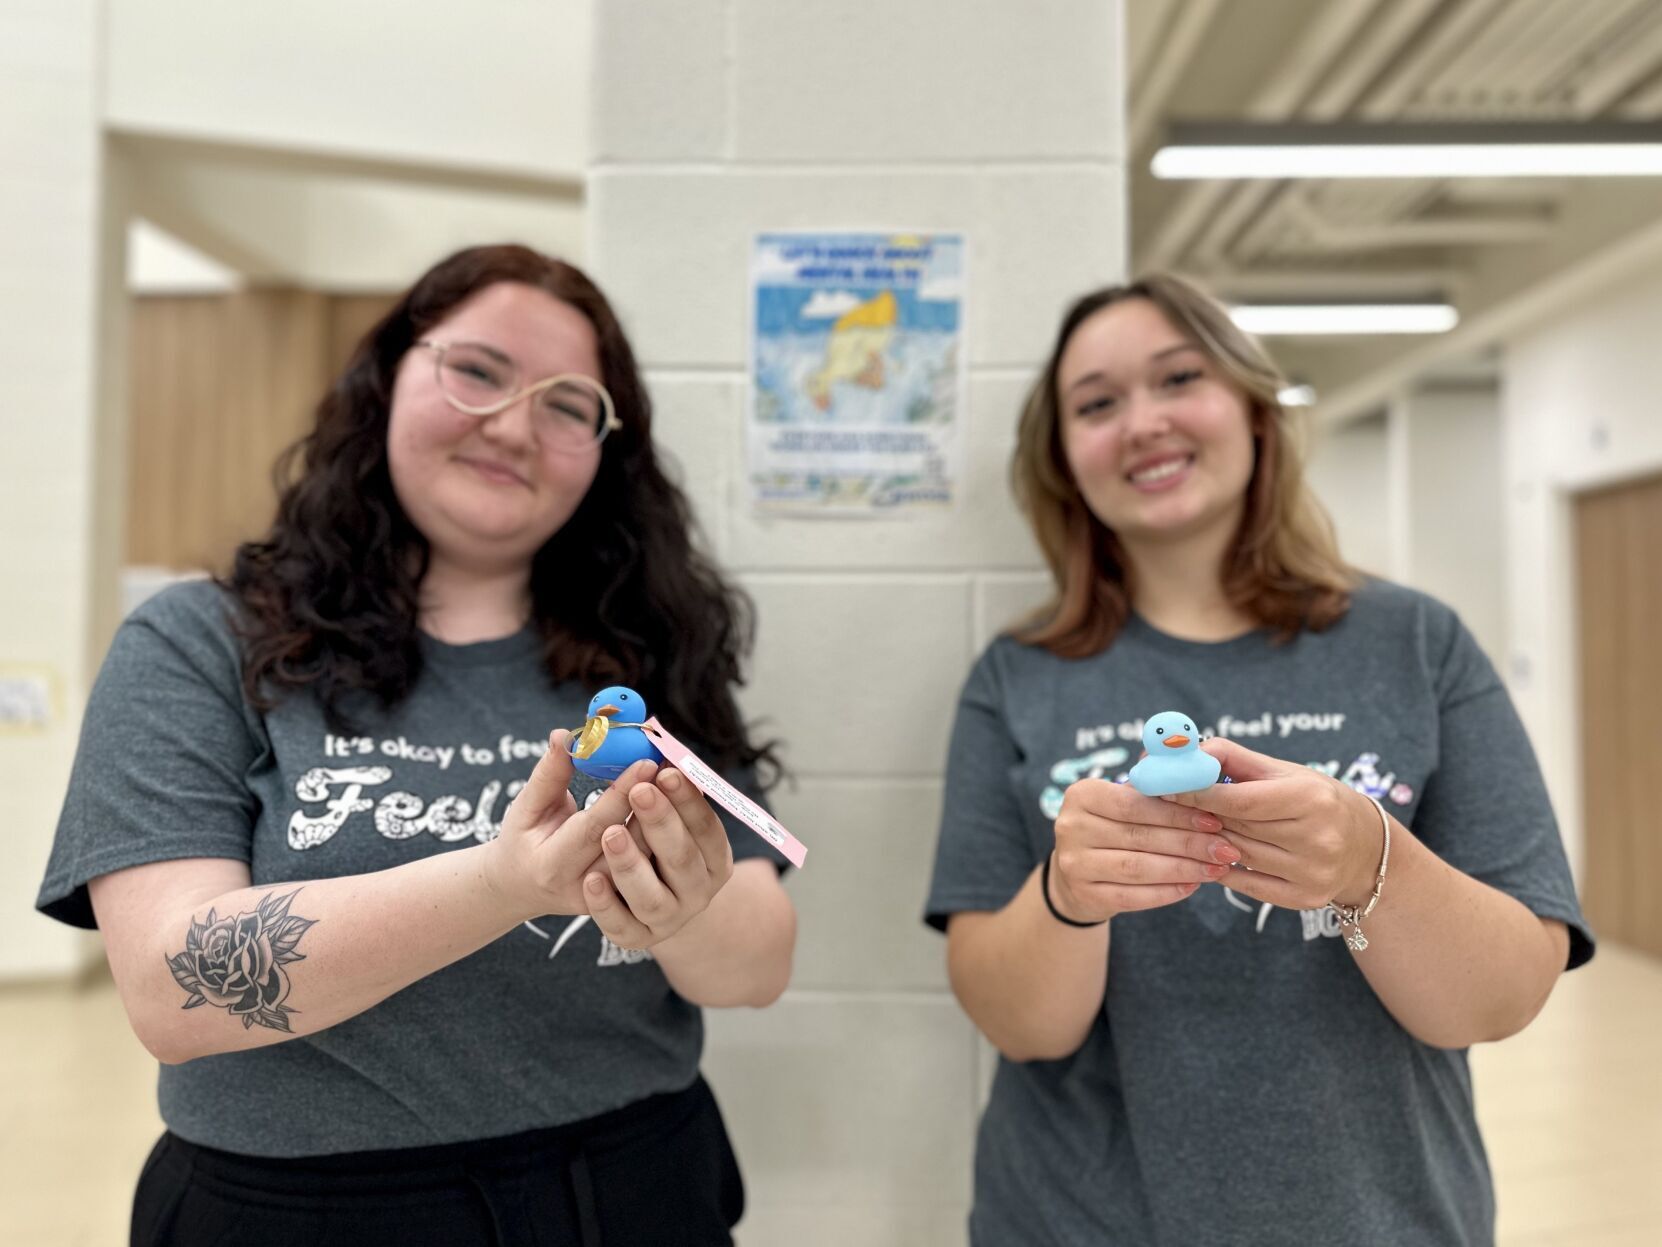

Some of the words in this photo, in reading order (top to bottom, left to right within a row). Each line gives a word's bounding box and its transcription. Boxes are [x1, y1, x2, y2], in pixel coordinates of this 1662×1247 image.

[1217, 711, 1273, 738] feel
[1276, 712, 1346, 738] your
[323, 733, 375, 758] It's
[379, 736, 455, 770] okay
[460, 743, 496, 766] to
[498, 734, 550, 763] fee
